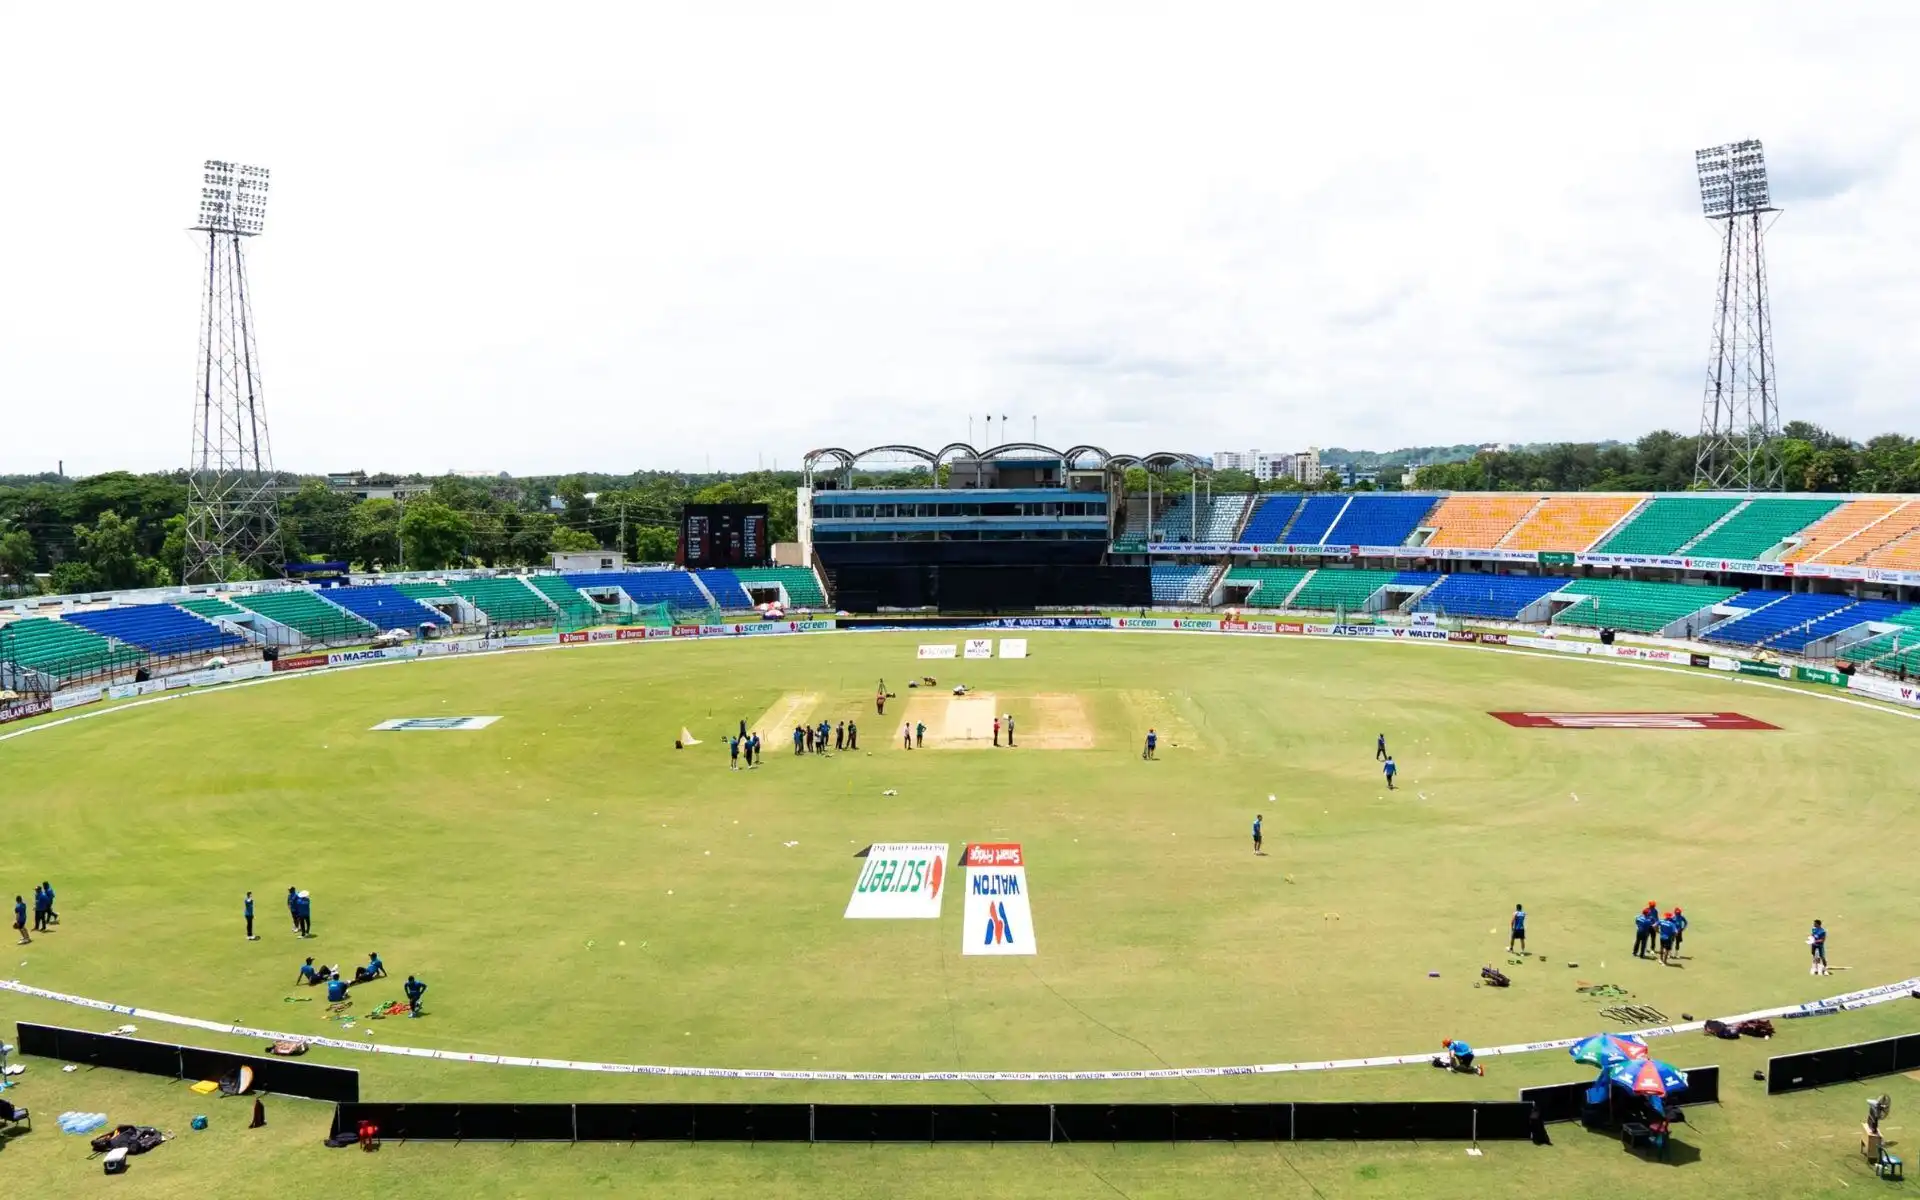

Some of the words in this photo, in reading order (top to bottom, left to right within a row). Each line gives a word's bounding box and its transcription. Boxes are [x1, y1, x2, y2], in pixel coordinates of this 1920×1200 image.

[1019, 618, 1055, 626] WALTON
[1075, 618, 1111, 626] WALTON
[1332, 625, 1357, 635] ATS
[1408, 629, 1446, 639] WALTON
[343, 650, 387, 661] MARCEL
[969, 846, 995, 865] Fridge
[996, 849, 1021, 864] Smart
[973, 874, 1020, 896] WALTON
